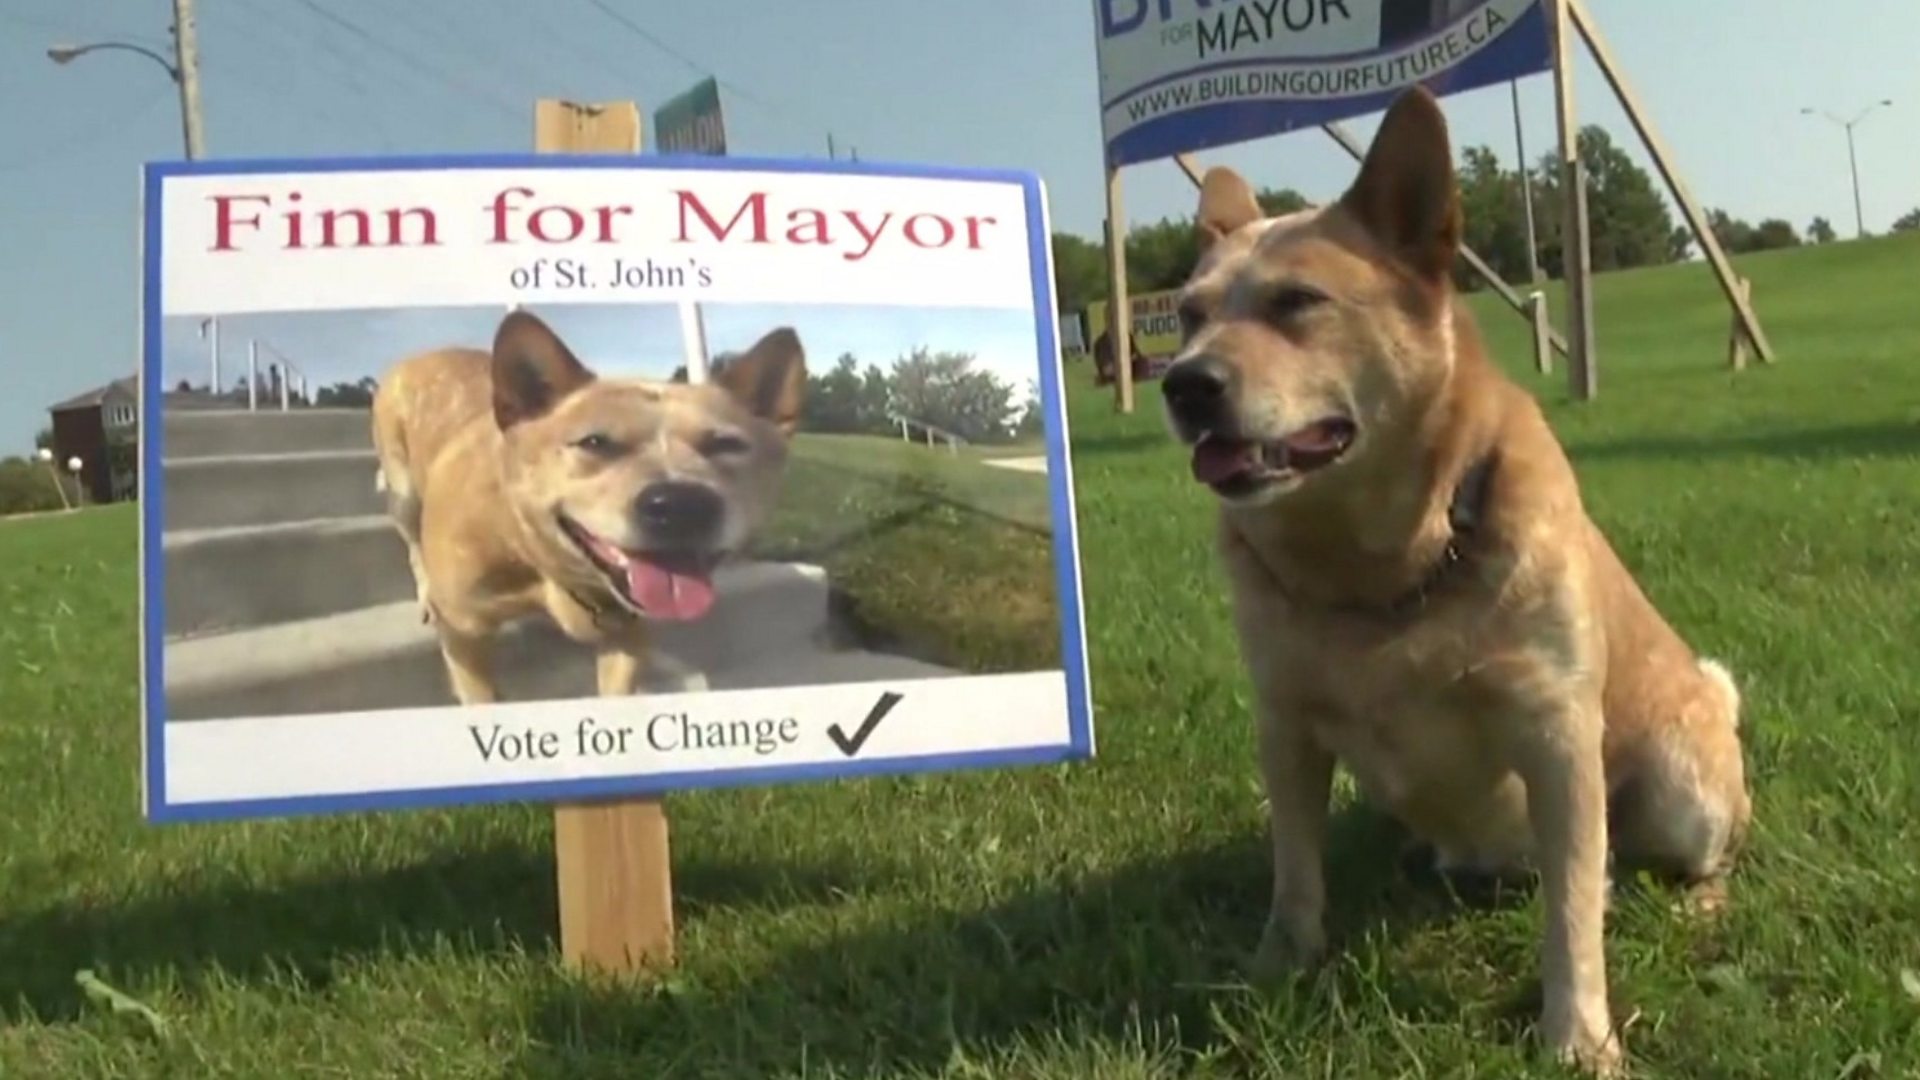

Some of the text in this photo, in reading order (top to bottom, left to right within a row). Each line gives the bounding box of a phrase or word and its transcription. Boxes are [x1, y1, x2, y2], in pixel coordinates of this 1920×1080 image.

[1160, 23, 1193, 46] FOR
[1197, 0, 1350, 59] MAYOR
[1126, 7, 1507, 121] WWW.BUILDINGOURFUTURE.CA
[207, 187, 998, 261] Finn for Mayor
[509, 259, 713, 290] of St. John's
[469, 712, 799, 762] Vote for Change
